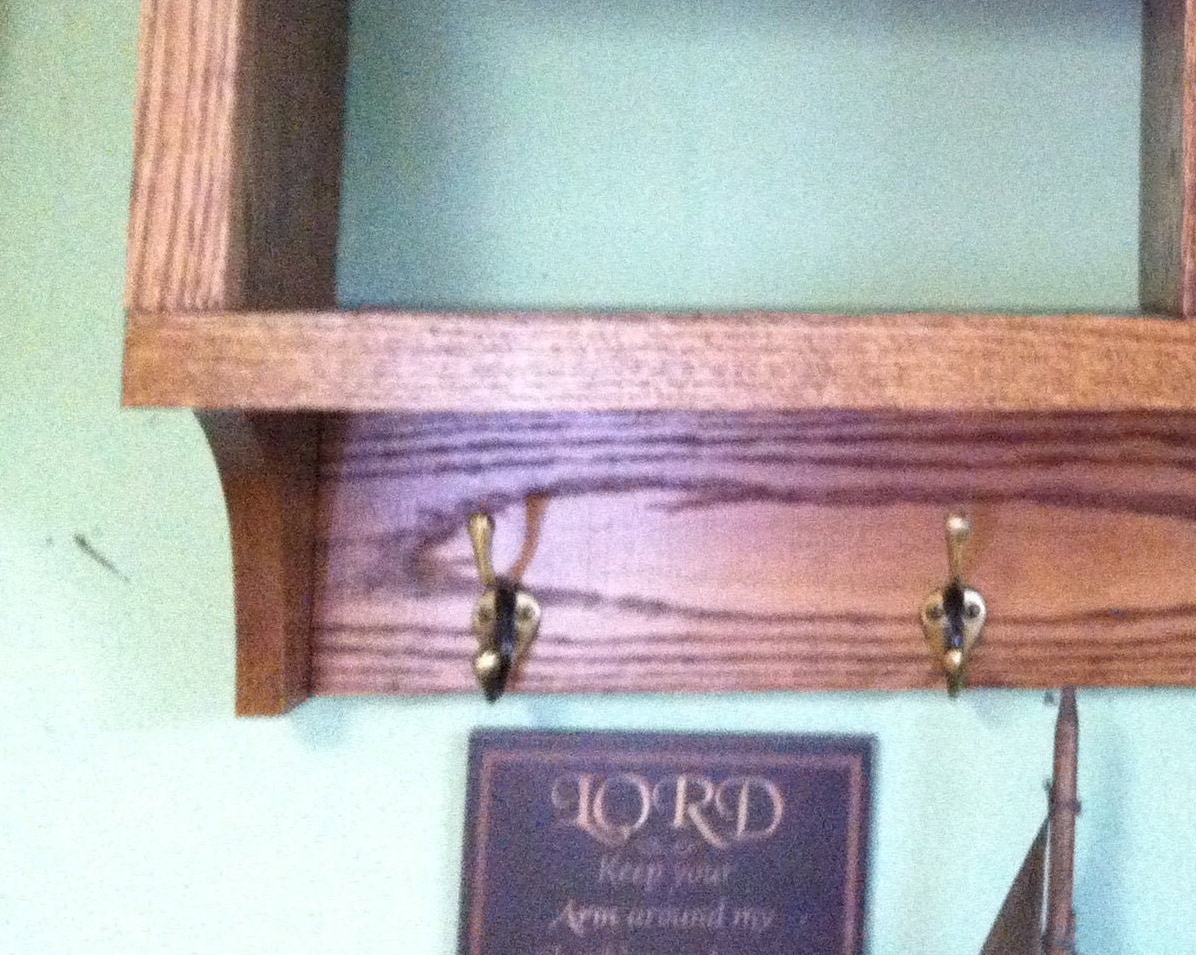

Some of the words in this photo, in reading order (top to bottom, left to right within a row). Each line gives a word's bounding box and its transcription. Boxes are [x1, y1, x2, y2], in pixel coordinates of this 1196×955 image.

[550, 772, 785, 849] LORD
[597, 853, 664, 891] Keep
[671, 861, 735, 894] your
[548, 898, 620, 938] Arm
[627, 897, 726, 929] around
[732, 905, 777, 935] my
